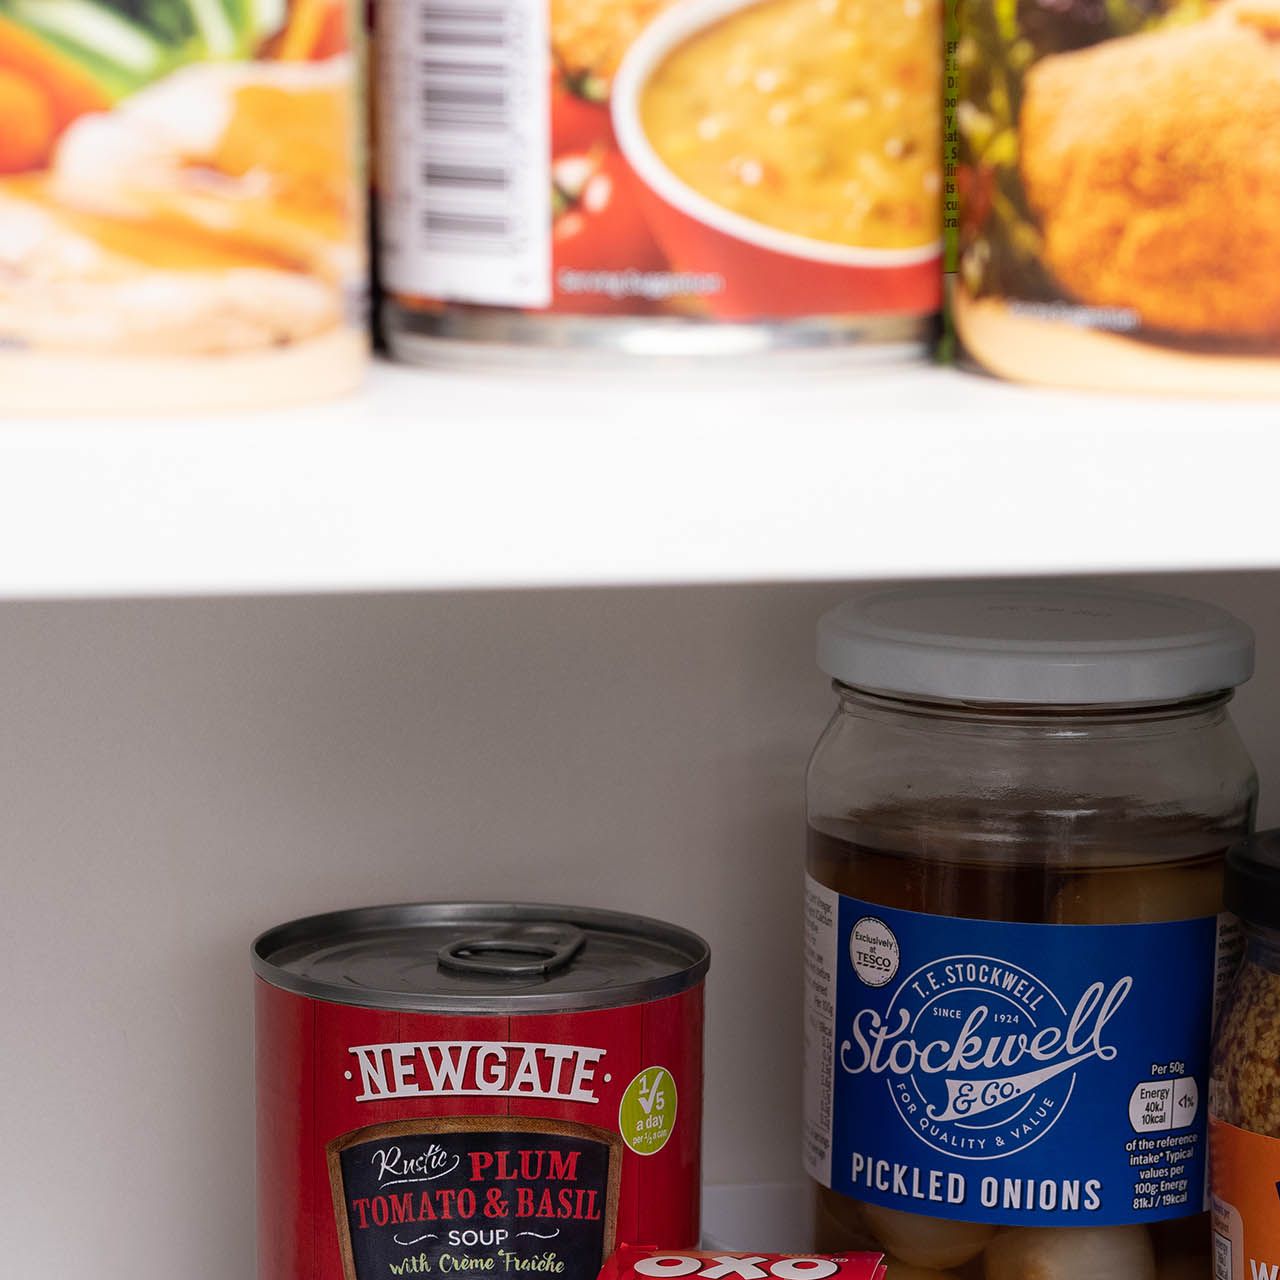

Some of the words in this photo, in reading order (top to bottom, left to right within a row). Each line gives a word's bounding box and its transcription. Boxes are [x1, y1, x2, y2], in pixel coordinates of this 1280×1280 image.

[856, 931, 893, 950] Exclusively
[869, 946, 876, 954] at
[857, 951, 891, 967] TESCO
[933, 1007, 961, 1019] SINCE
[994, 1014, 1019, 1024] 1924
[841, 976, 1132, 1074] Stockwell
[348, 1041, 606, 1104] NEWGATE
[1152, 1064, 1168, 1075] Per
[1169, 1062, 1184, 1074] 50g
[953, 1083, 977, 1114] &
[1140, 1088, 1170, 1100] Energy
[897, 1083, 917, 1115] FOR
[918, 1117, 986, 1149] QUALITY
[996, 1136, 1005, 1147] &
[1010, 1096, 1055, 1139] VALUE
[1145, 1102, 1164, 1113] 40kJ
[636, 1120, 643, 1131] a
[646, 1114, 664, 1129] day
[1142, 1113, 1165, 1125] 10kcal
[1126, 1139, 1137, 1151] of
[1139, 1139, 1155, 1150] the
[1157, 1134, 1198, 1149] reference
[1166, 1148, 1194, 1164] Typical
[371, 1143, 460, 1187] Rustic
[468, 1150, 581, 1182] PLUM
[1140, 1167, 1168, 1179] values
[1170, 1165, 1184, 1178] per
[852, 1153, 966, 1205] PICKLED
[980, 1177, 1102, 1211] ONIONS
[1134, 1183, 1158, 1196] 100g:
[1160, 1179, 1188, 1192] Energy
[353, 1188, 477, 1229] TOMATO
[483, 1188, 510, 1219] &
[515, 1188, 600, 1220] BASIL
[1133, 1198, 1154, 1209] 81kJ
[1162, 1192, 1188, 1206] 19kcal
[448, 1229, 509, 1246] SOUP
[390, 1251, 431, 1274] with
[439, 1252, 494, 1274] Crème
[498, 1249, 565, 1273] Fraîche
